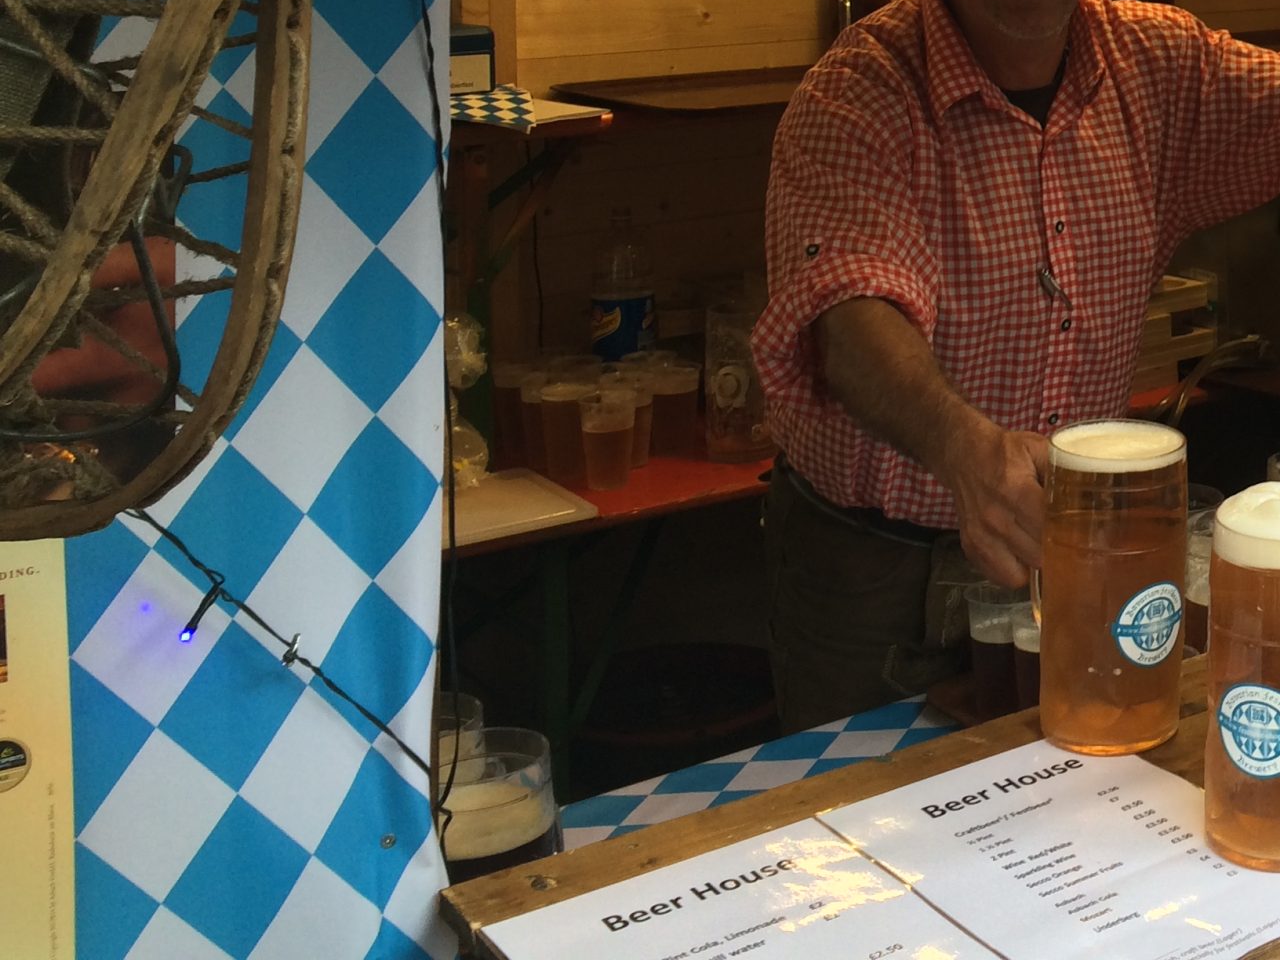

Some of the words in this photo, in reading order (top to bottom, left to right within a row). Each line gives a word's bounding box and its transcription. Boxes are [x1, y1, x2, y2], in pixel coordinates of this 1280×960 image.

[921, 789, 990, 819] Beer
[993, 758, 1084, 794] House
[1002, 858, 1026, 871] Wine
[1027, 841, 1073, 861] Red/White
[1014, 861, 1055, 880] Sparkling
[1055, 853, 1076, 865] Wine
[1052, 864, 1083, 879] Orange
[1064, 871, 1099, 888] Summer
[1099, 861, 1123, 874] Fruits
[601, 896, 683, 932] Beer
[690, 858, 794, 901] House
[690, 940, 724, 954] Cola,
[724, 916, 786, 942] Limonade
[1093, 911, 1141, 933] Underberg
[728, 939, 765, 957] water
